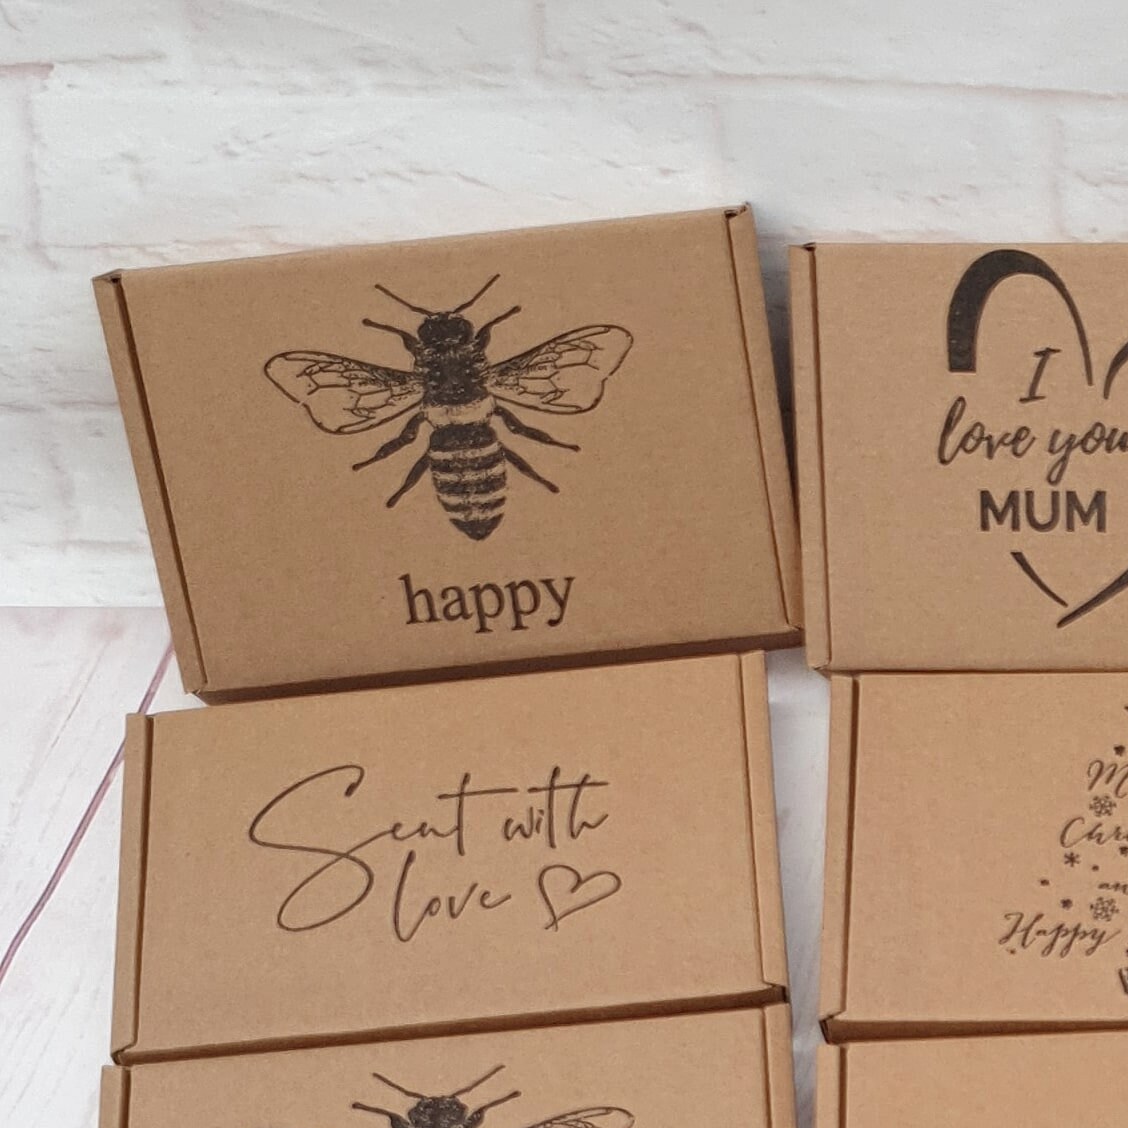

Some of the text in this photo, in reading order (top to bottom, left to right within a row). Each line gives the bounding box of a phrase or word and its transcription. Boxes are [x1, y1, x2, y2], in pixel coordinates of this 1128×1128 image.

[1019, 346, 1062, 403] I
[937, 396, 1036, 466] love
[979, 490, 1107, 533] MUM
[400, 572, 575, 633] happy
[248, 764, 610, 932] Sent with
[393, 849, 512, 943] love
[998, 911, 1121, 958] Happy
